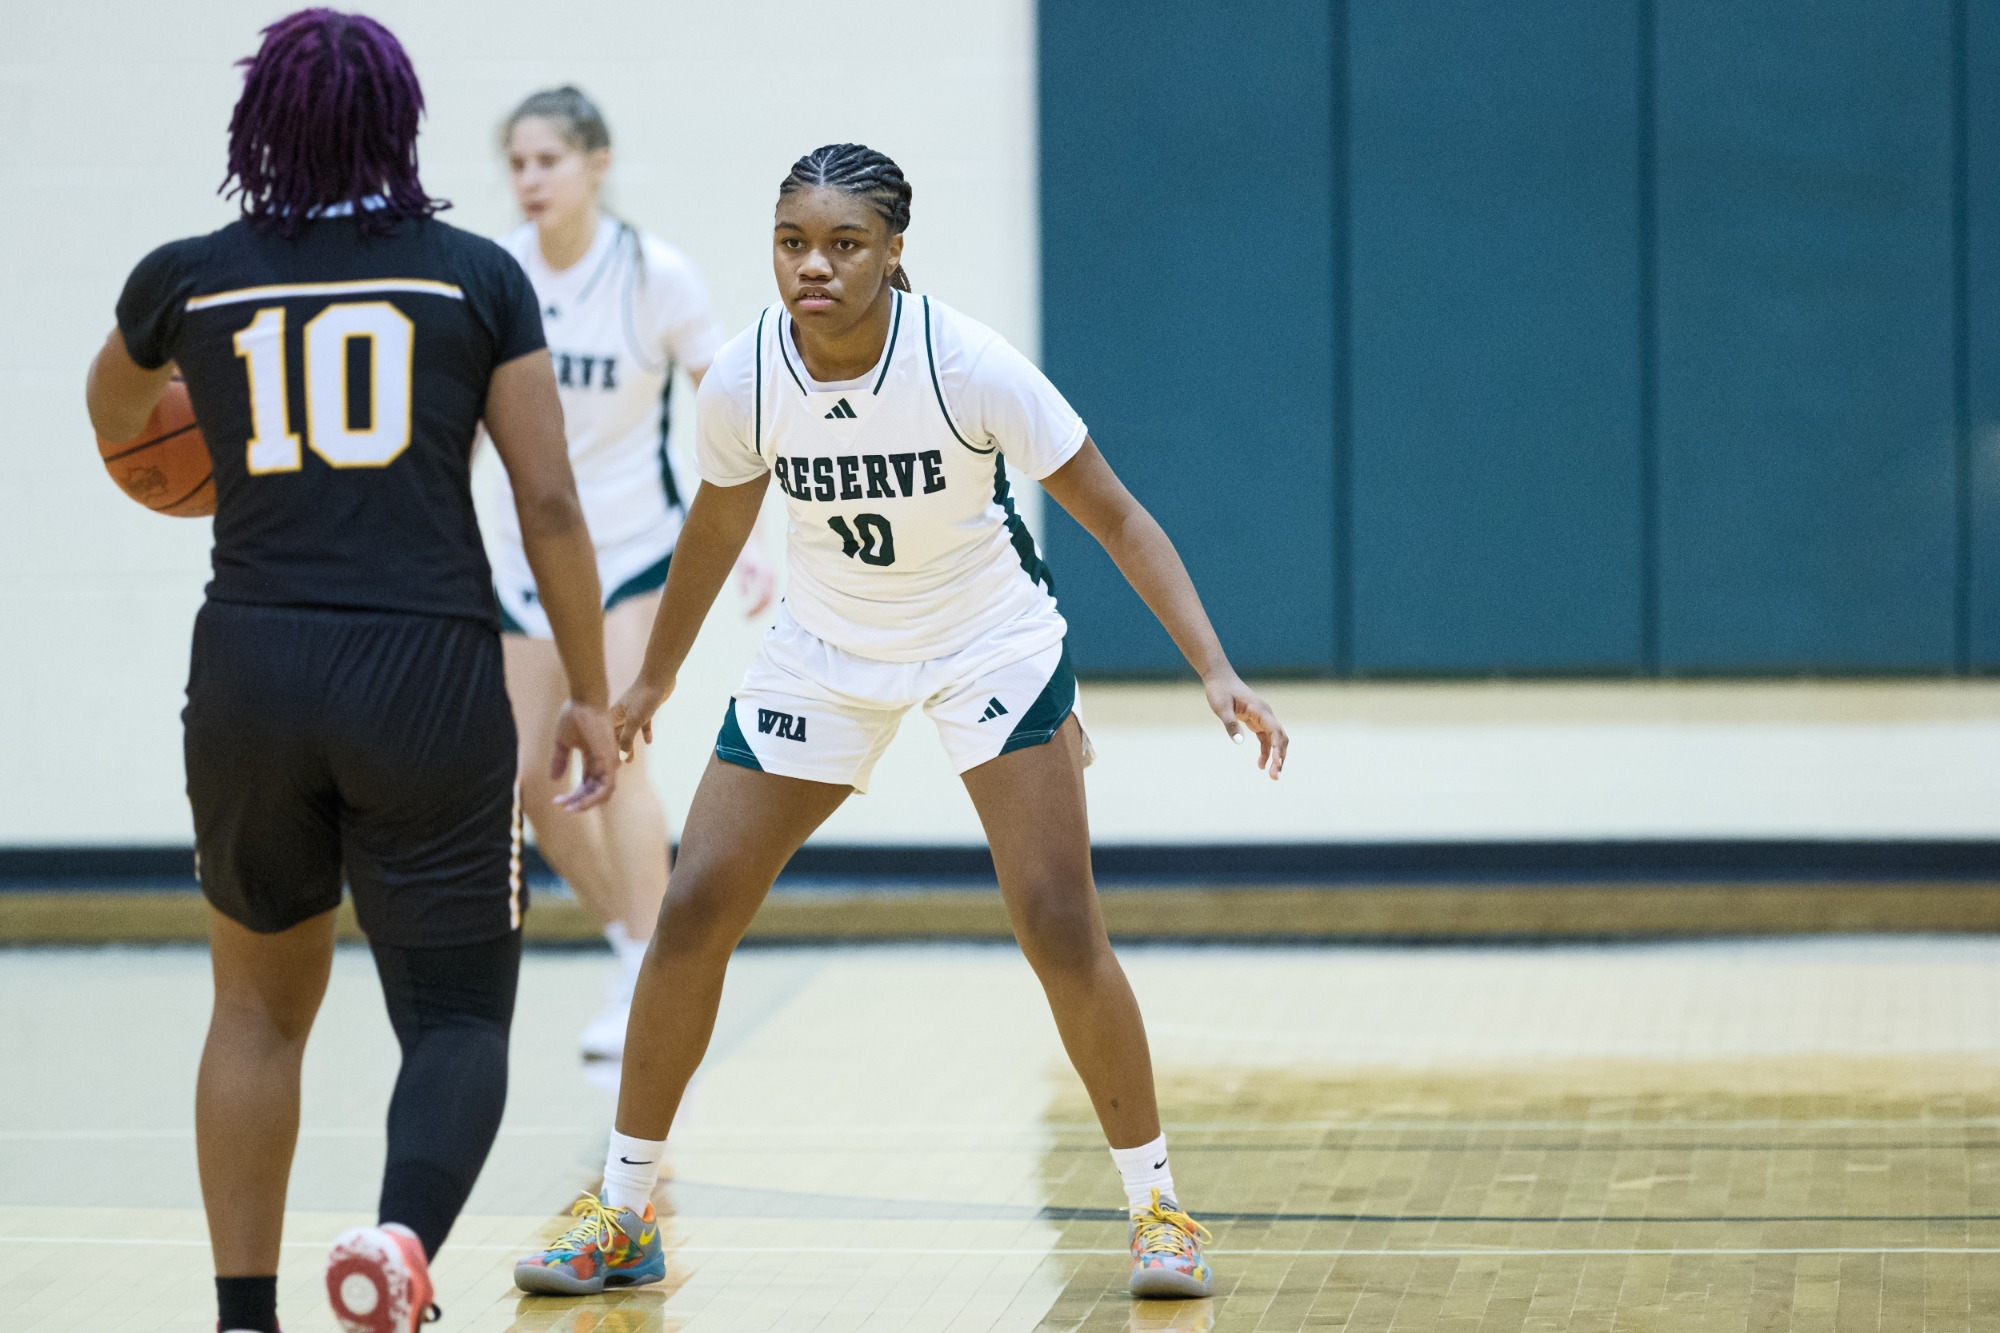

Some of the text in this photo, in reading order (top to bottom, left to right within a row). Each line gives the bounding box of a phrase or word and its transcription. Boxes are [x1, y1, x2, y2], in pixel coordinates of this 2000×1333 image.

[233, 301, 415, 476] 10
[775, 450, 946, 502] RESERVE
[827, 513, 896, 566] 10
[758, 708, 806, 742] WRA
